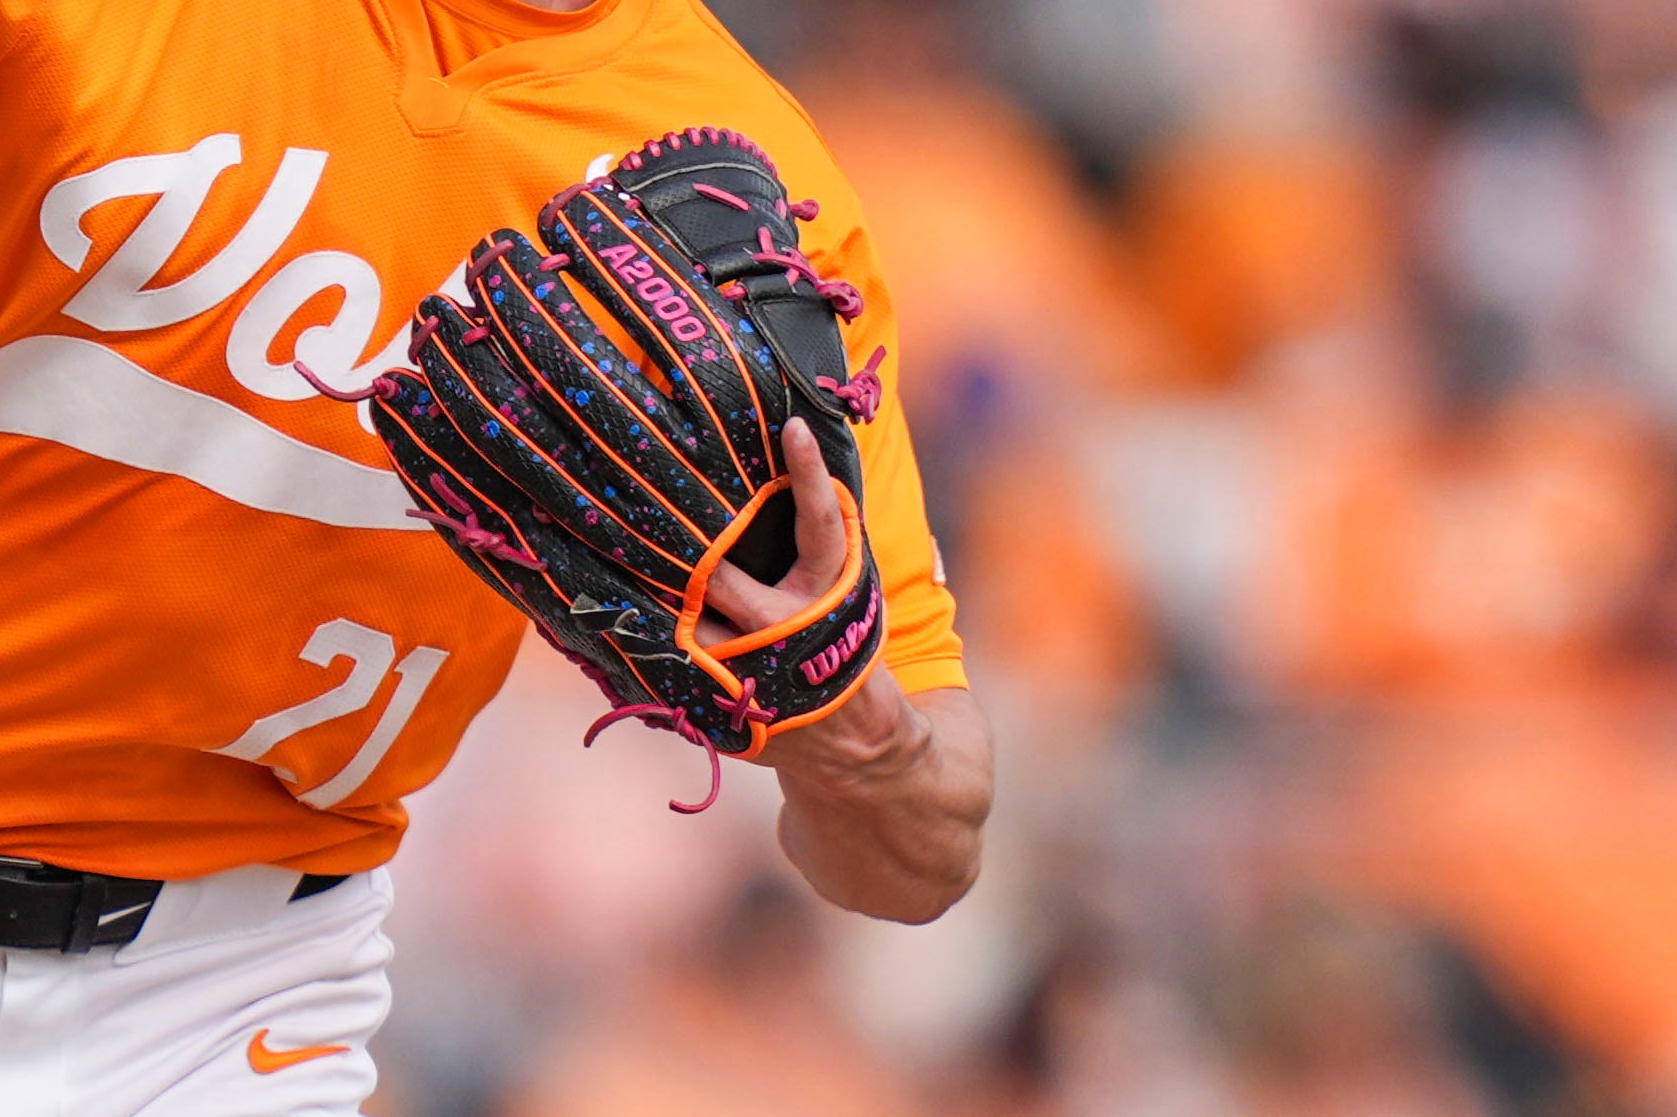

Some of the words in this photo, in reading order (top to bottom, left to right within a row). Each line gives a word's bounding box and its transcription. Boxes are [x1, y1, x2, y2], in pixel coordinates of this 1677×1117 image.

[39, 133, 477, 435] Vo
[597, 244, 707, 342] A2000
[200, 617, 451, 811] 21
